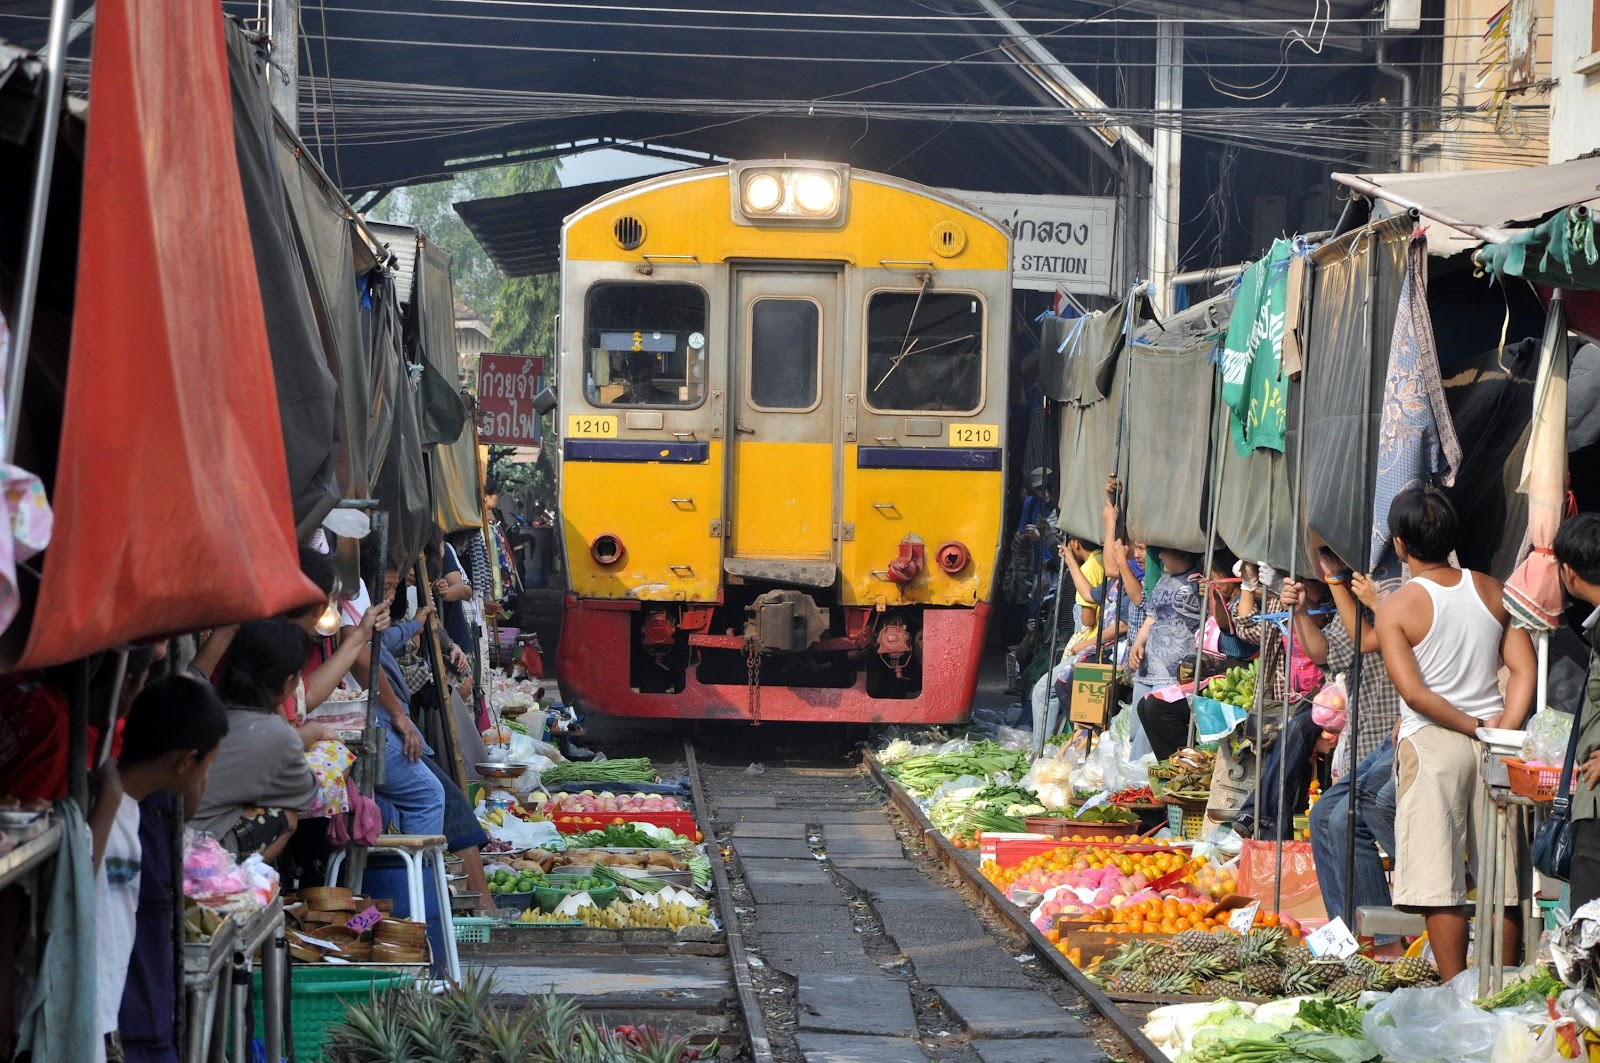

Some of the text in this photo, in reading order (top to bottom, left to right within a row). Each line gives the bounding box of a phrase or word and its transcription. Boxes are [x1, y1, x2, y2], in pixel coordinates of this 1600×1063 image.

[1021, 254, 1088, 275] STATION
[483, 398, 536, 439] รถไฟ
[575, 420, 611, 434] 1210
[956, 429, 992, 442] 1210
